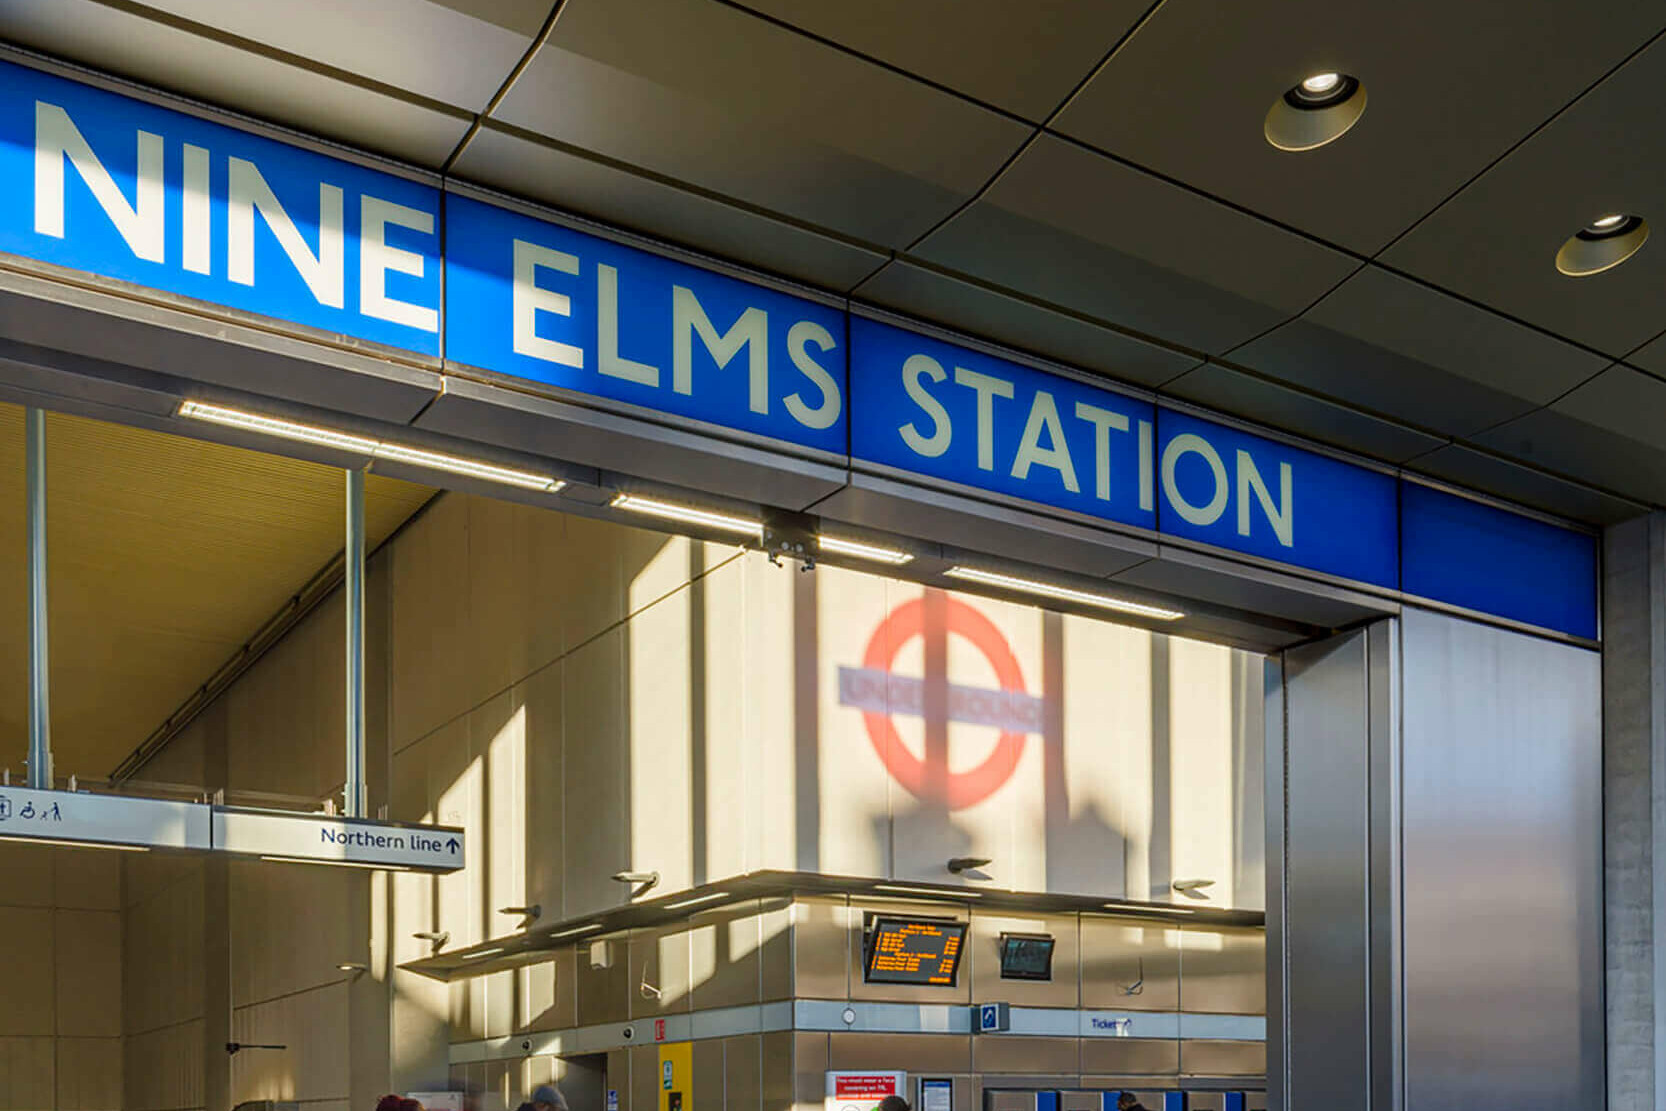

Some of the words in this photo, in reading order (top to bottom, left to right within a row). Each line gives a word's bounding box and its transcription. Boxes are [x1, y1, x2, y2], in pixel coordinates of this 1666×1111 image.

[34, 101, 438, 333] NINE
[512, 239, 842, 430] ELMS
[899, 354, 1293, 547] STATION
[321, 828, 404, 849] Northern
[410, 835, 442, 852] line
